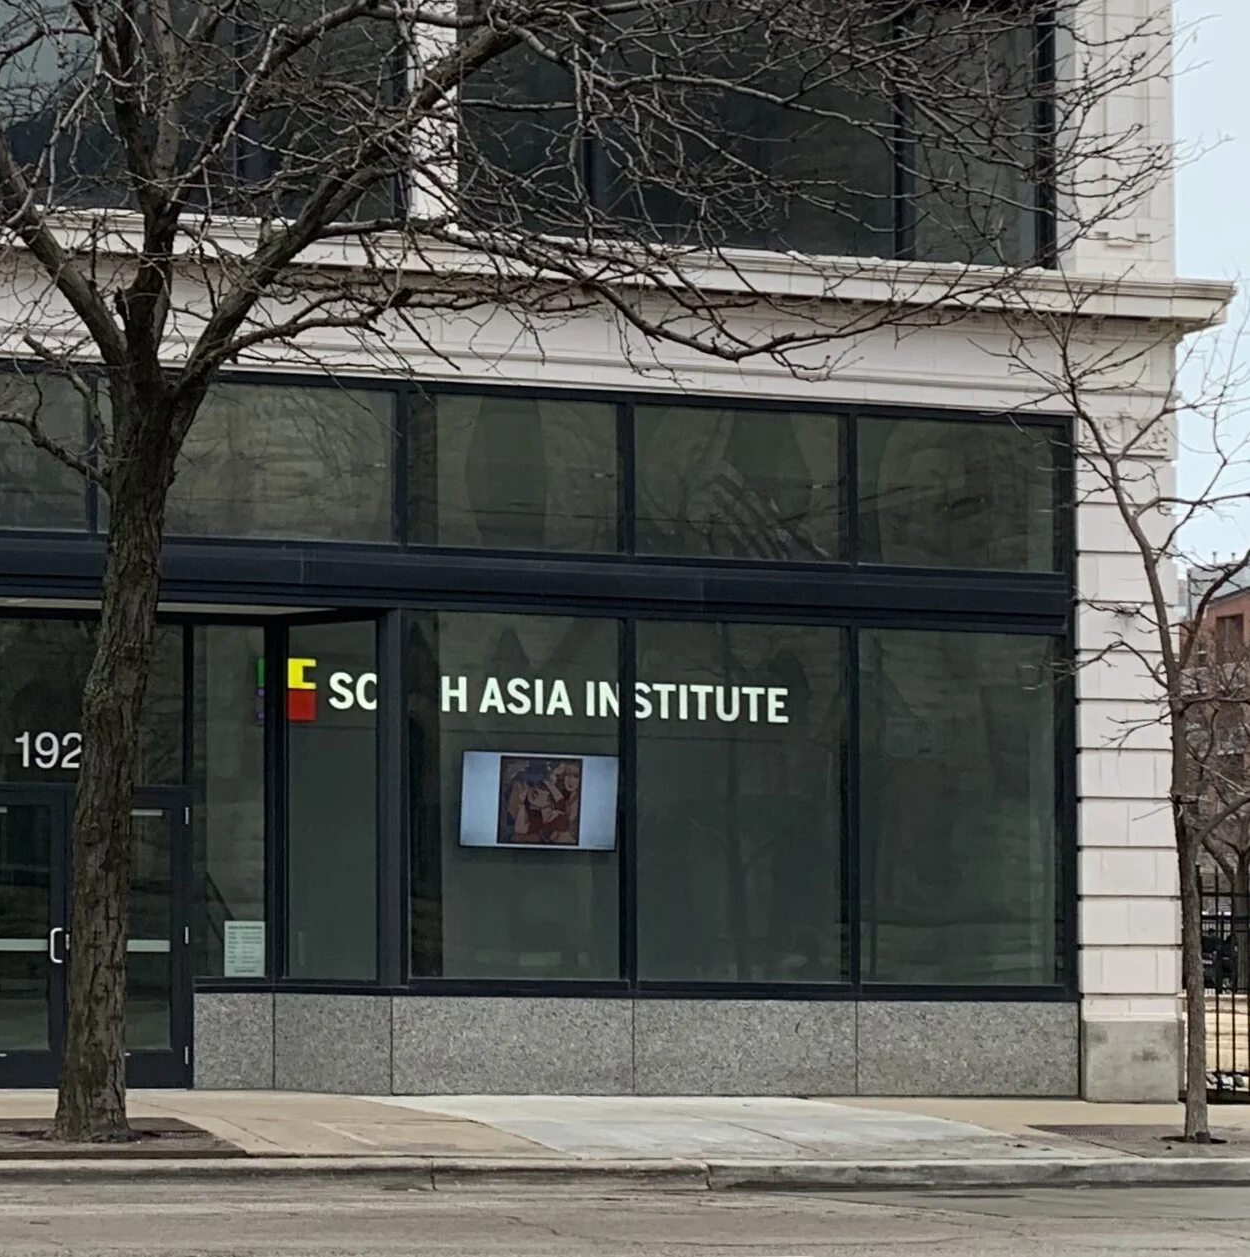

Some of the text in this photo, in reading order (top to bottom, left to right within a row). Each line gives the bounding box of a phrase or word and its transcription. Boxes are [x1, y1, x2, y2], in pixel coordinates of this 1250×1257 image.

[328, 672, 789, 723] SOH ASIA INSTITUTE
